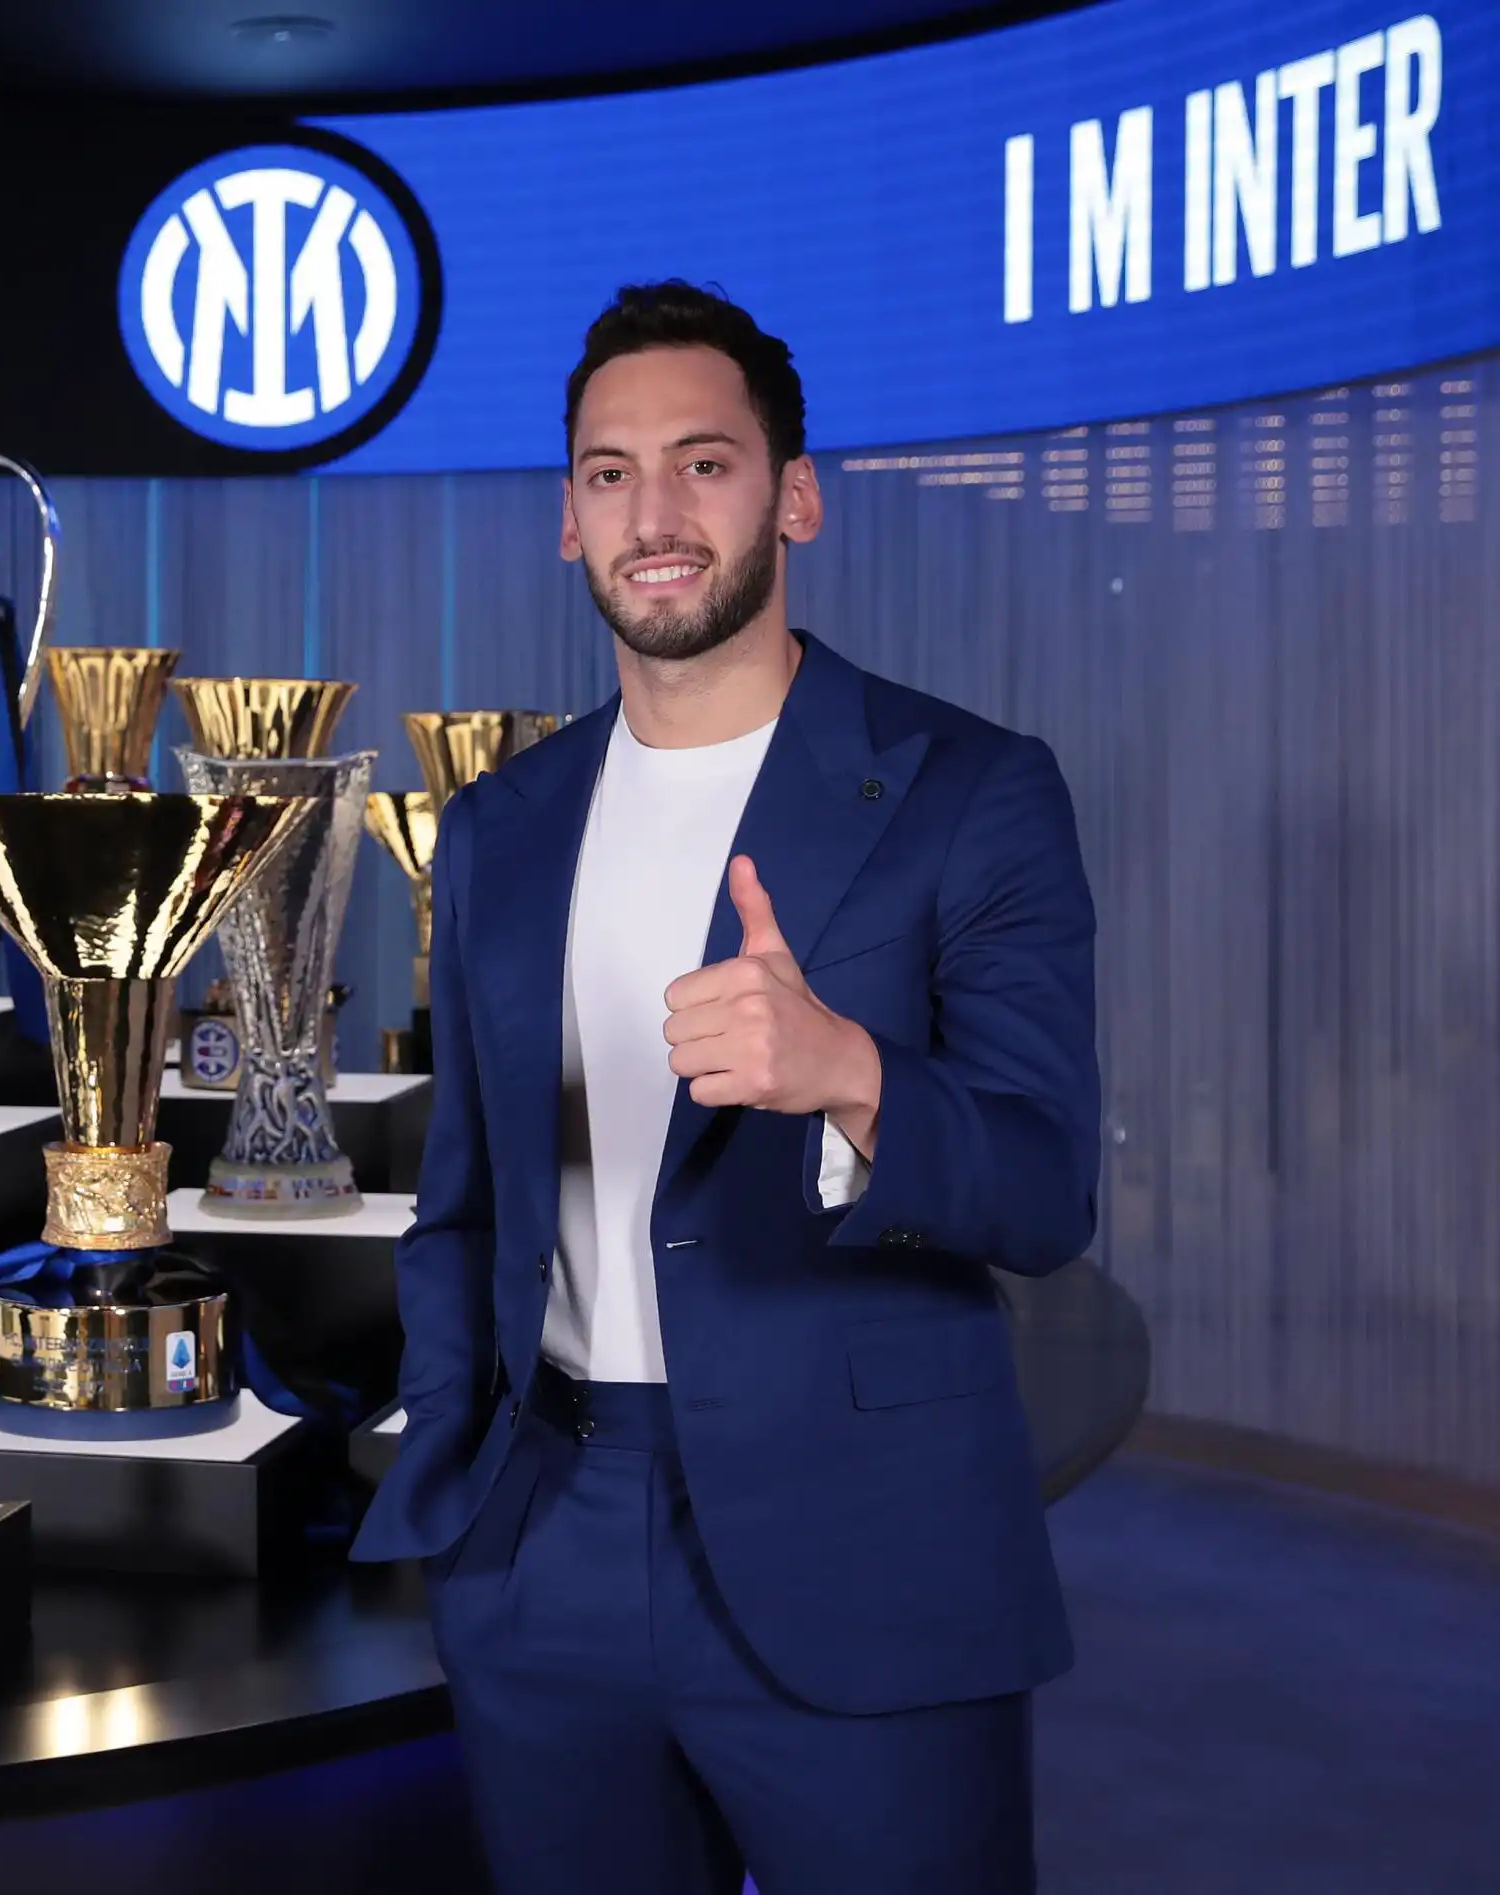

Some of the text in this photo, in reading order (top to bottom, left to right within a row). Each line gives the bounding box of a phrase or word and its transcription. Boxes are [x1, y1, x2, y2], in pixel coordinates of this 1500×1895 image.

[1005, 17, 1440, 322] I M INTER
